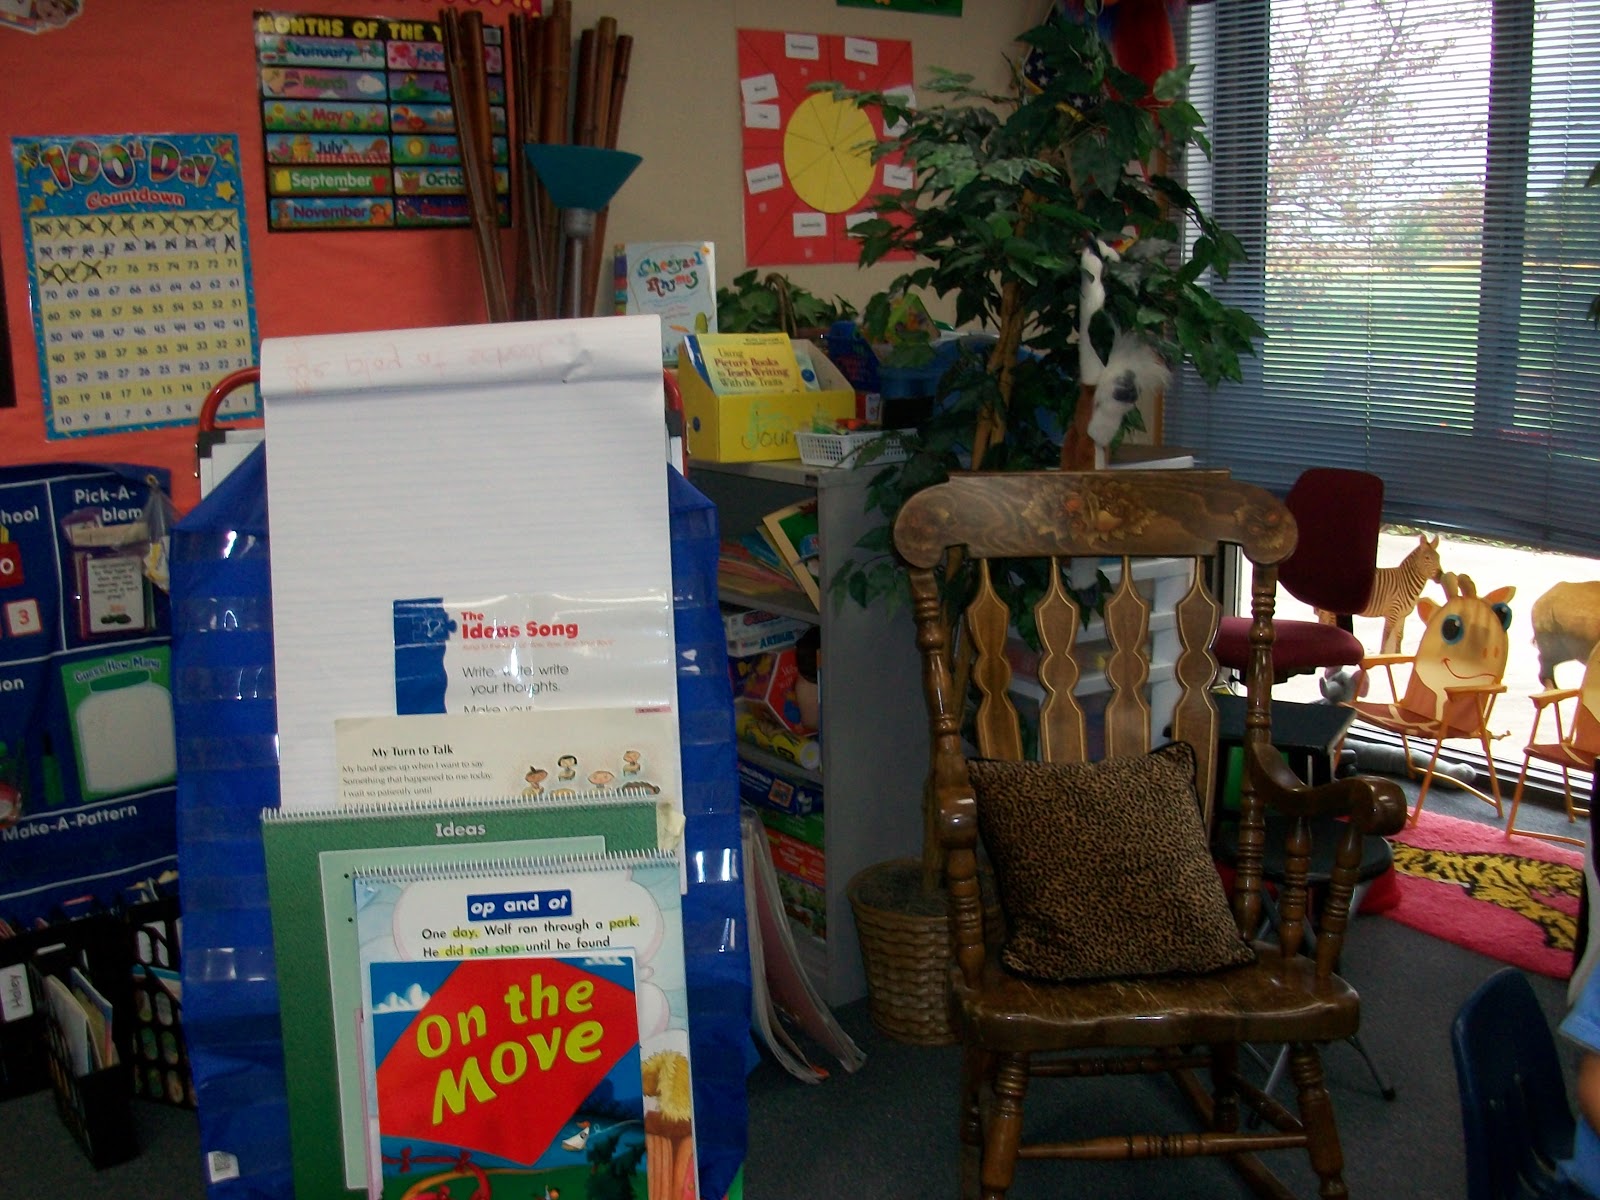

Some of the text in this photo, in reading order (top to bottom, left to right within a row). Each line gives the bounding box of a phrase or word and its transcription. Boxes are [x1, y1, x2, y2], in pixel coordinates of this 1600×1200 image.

[258, 16, 344, 37] MONTHS
[352, 20, 379, 38] OF
[388, 23, 424, 41] THE
[312, 107, 343, 123] May
[315, 140, 343, 155] July
[428, 143, 459, 157] Aug
[149, 139, 217, 187] Day
[291, 172, 372, 190] September
[426, 169, 465, 186] Octob
[86, 190, 187, 210] Countdown
[293, 206, 368, 219] November
[714, 357, 779, 367] Picture Books
[727, 368, 752, 377] Teach
[752, 367, 789, 378] Writing
[719, 377, 783, 387] With the Traits
[74, 488, 138, 505] Pick-A-
[101, 505, 144, 523] blem
[18, 609, 30, 625] 3
[461, 611, 484, 621] The
[462, 620, 579, 639] Ideas Song
[539, 664, 570, 675] write
[470, 684, 499, 696] your
[372, 744, 454, 758] My Turn to Talk
[342, 765, 354, 773] My
[356, 763, 377, 772] hand
[379, 765, 397, 773] goes
[399, 764, 410, 772] up
[412, 761, 433, 770] when
[440, 761, 460, 769] want
[343, 776, 387, 786] Something
[388, 775, 402, 783] that
[404, 774, 444, 784] happened
[377, 787, 411, 798] patiently
[414, 786, 432, 795] until
[2, 803, 138, 842] Make-A-Pattern
[435, 821, 487, 838] Ideas
[470, 900, 496, 918] op
[503, 894, 540, 914] and
[421, 927, 447, 940] One
[484, 923, 512, 937] Wolf
[517, 924, 538, 935] ran
[544, 919, 589, 934] through
[595, 921, 604, 931] a
[608, 916, 640, 932] park.
[422, 936, 611, 957] He did not stop until he found
[415, 973, 595, 1059] On the
[431, 1019, 604, 1126] Move
